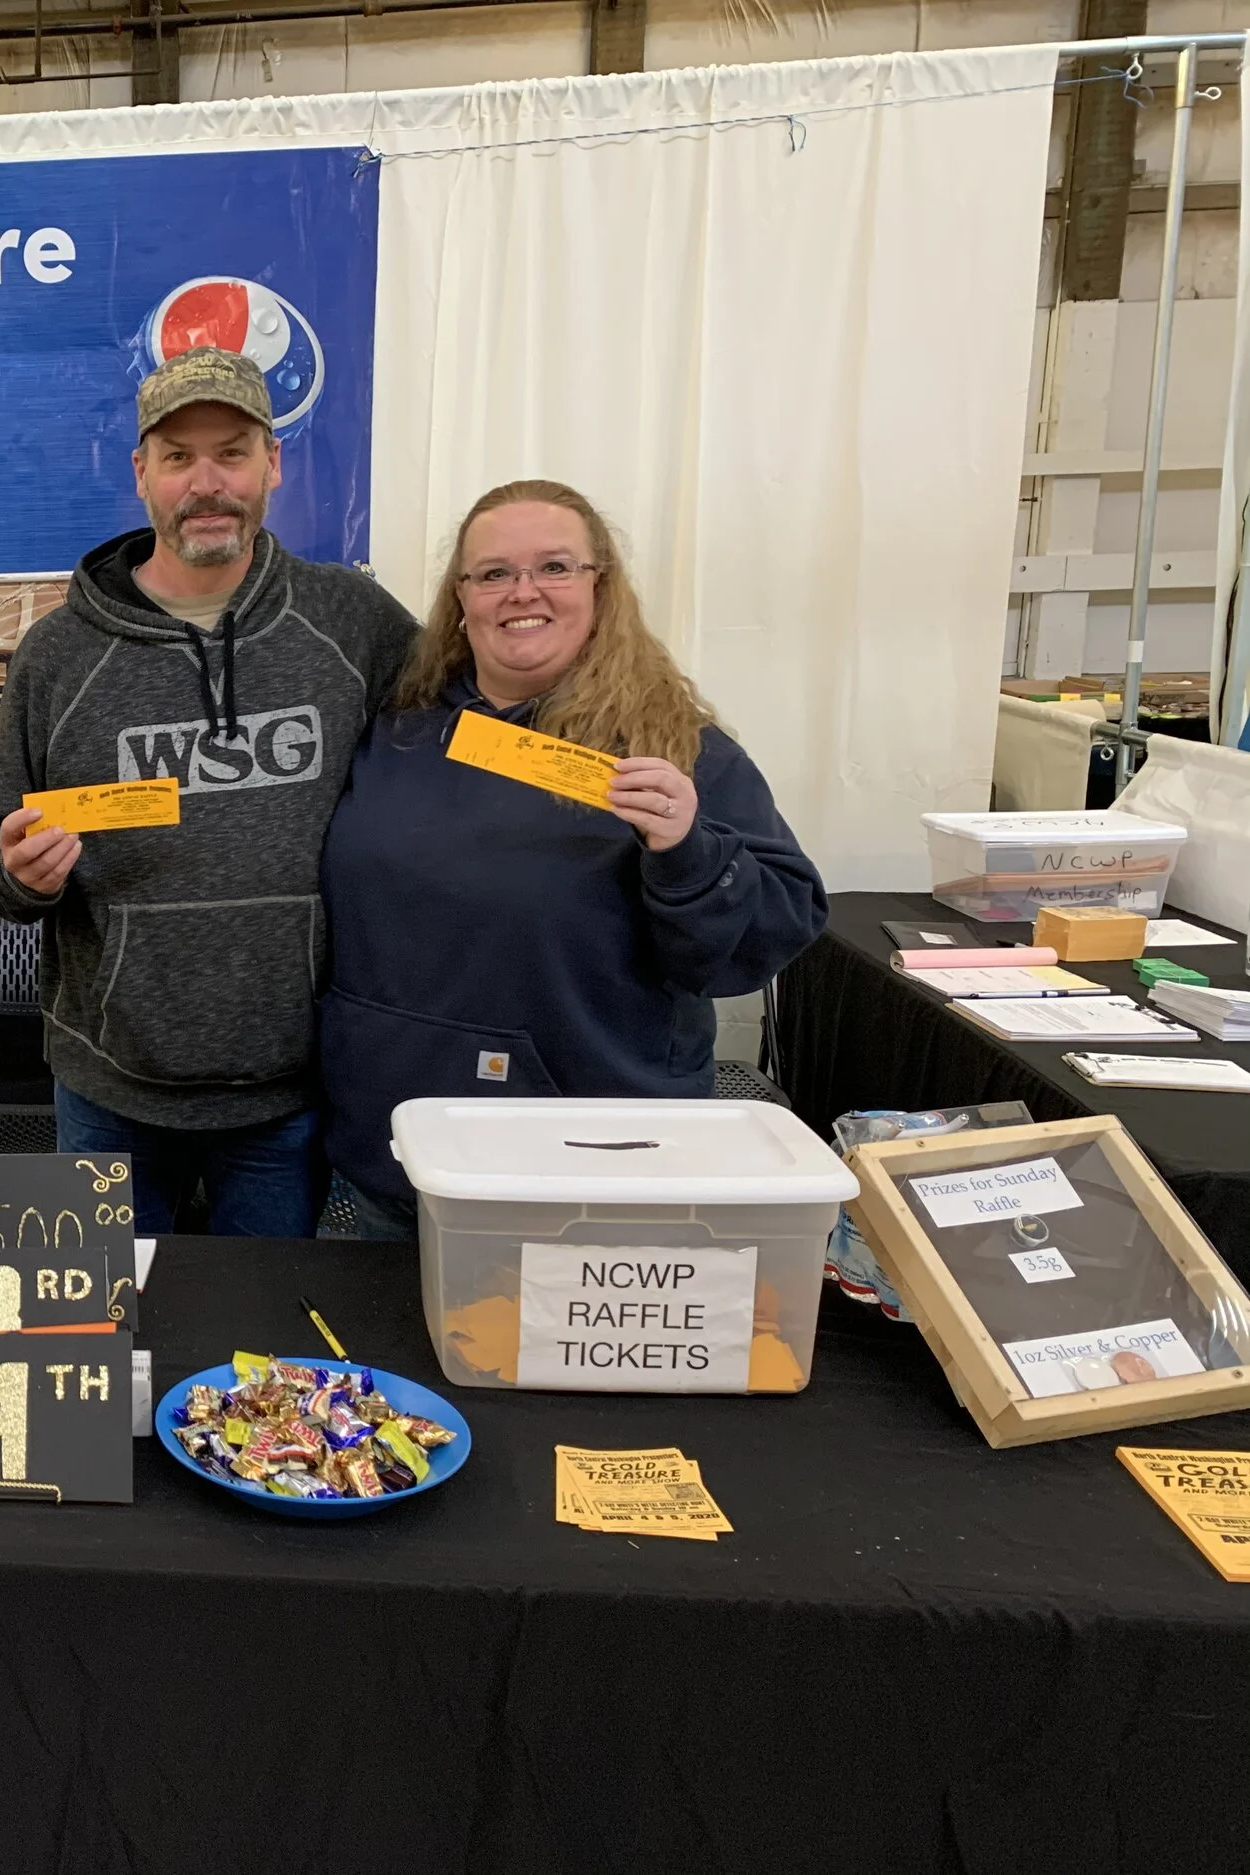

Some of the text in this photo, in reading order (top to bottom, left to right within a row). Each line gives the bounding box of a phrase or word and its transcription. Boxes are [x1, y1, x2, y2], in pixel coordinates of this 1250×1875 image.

[124, 713, 318, 789] WSG
[1041, 851, 1134, 871] NCWP
[1022, 880, 1143, 904] Membership
[917, 1167, 1058, 1198] Prizes for Sunday
[973, 1196, 1022, 1214] Raffle
[1023, 1255, 1063, 1272] 3.5g
[580, 1261, 695, 1290] NCWP
[567, 1301, 706, 1331] RAFFLE
[556, 1340, 710, 1371] TICKETS
[1013, 1330, 1179, 1365] 1oz Silver & Copper
[600, 1462, 657, 1472] GOLD
[642, 1453, 679, 1461] Prospectors
[1132, 1452, 1157, 1460] North
[1156, 1453, 1188, 1462] Central
[1187, 1455, 1237, 1464] Washington
[585, 1469, 682, 1481] TREASURE
